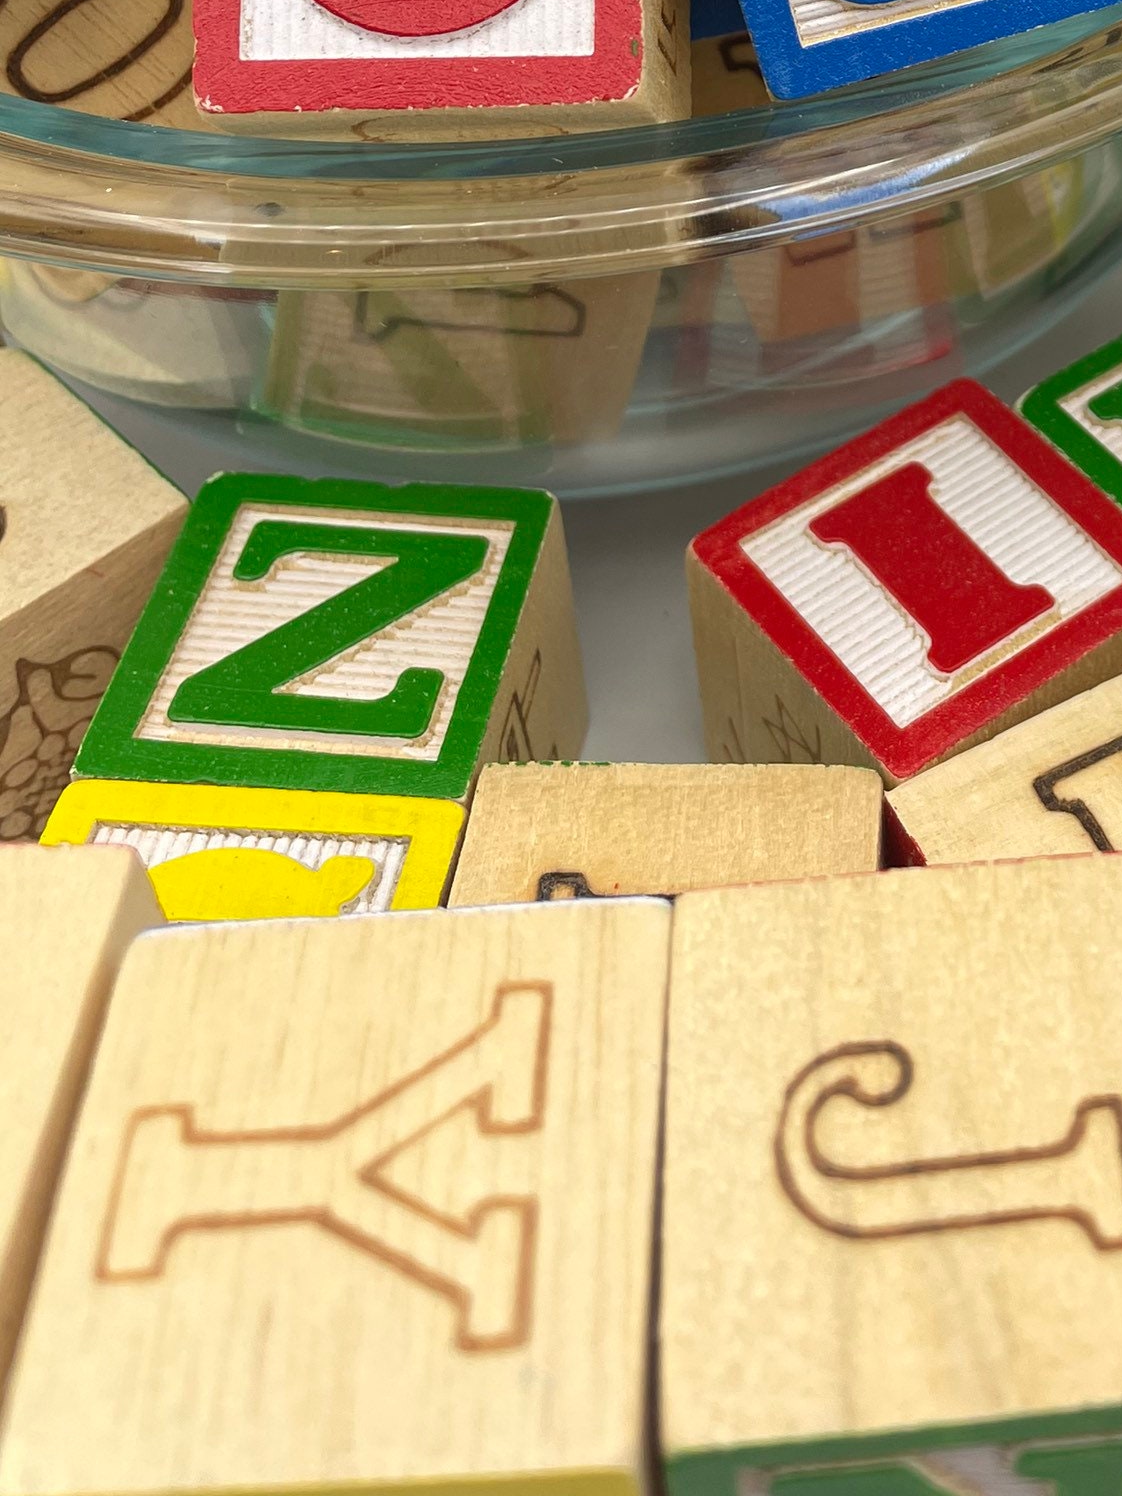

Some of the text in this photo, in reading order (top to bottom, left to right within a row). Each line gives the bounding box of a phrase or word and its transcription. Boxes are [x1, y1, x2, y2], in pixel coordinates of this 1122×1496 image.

[167, 520, 491, 740] Z
[809, 460, 1055, 674] I
[94, 979, 554, 1355] Y
